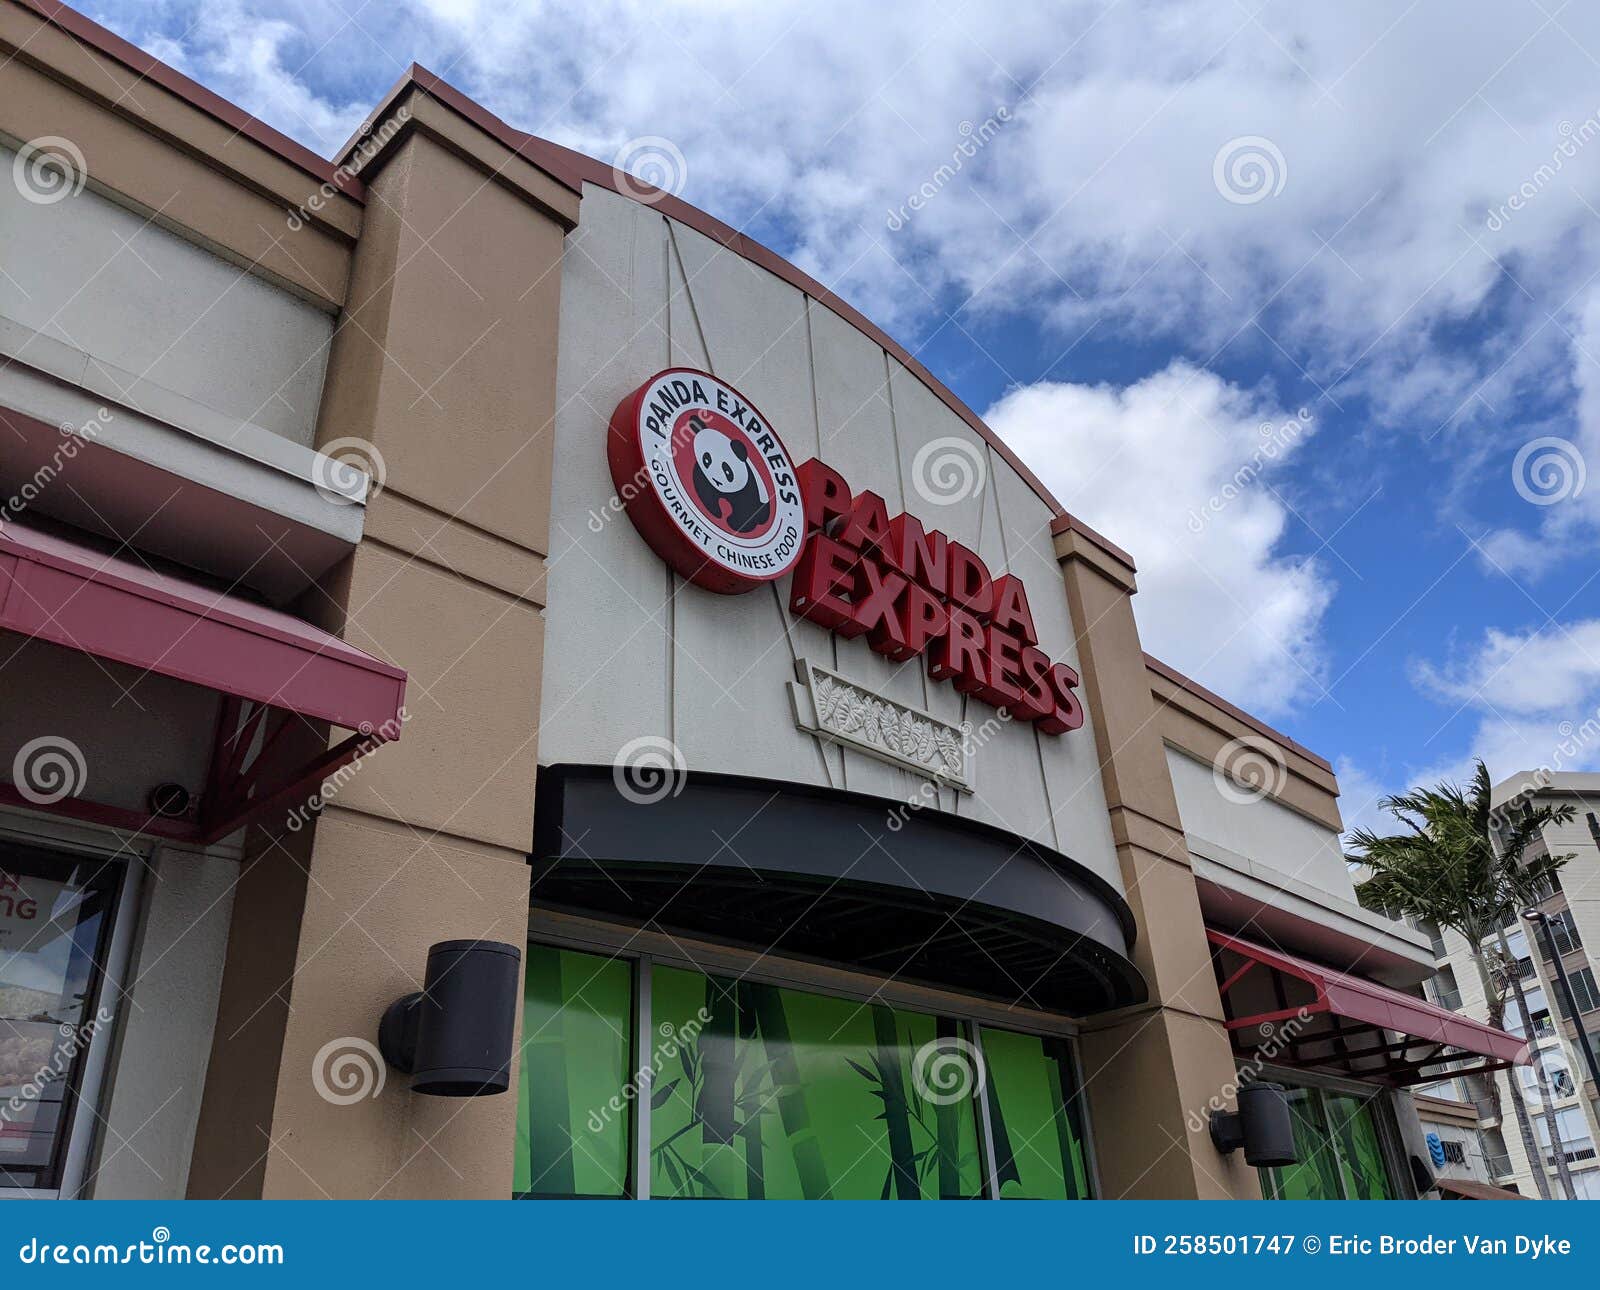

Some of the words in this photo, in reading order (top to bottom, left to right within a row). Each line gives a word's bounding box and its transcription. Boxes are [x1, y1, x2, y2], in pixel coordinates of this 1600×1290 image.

[646, 380, 709, 439] PANDA
[716, 388, 799, 506] EXPRESS
[651, 458, 712, 546] GOURMET
[717, 544, 776, 570] CHINESE
[775, 526, 798, 562] FOOD
[806, 457, 1038, 646] PANDA
[806, 533, 1084, 729] EXPRESS
